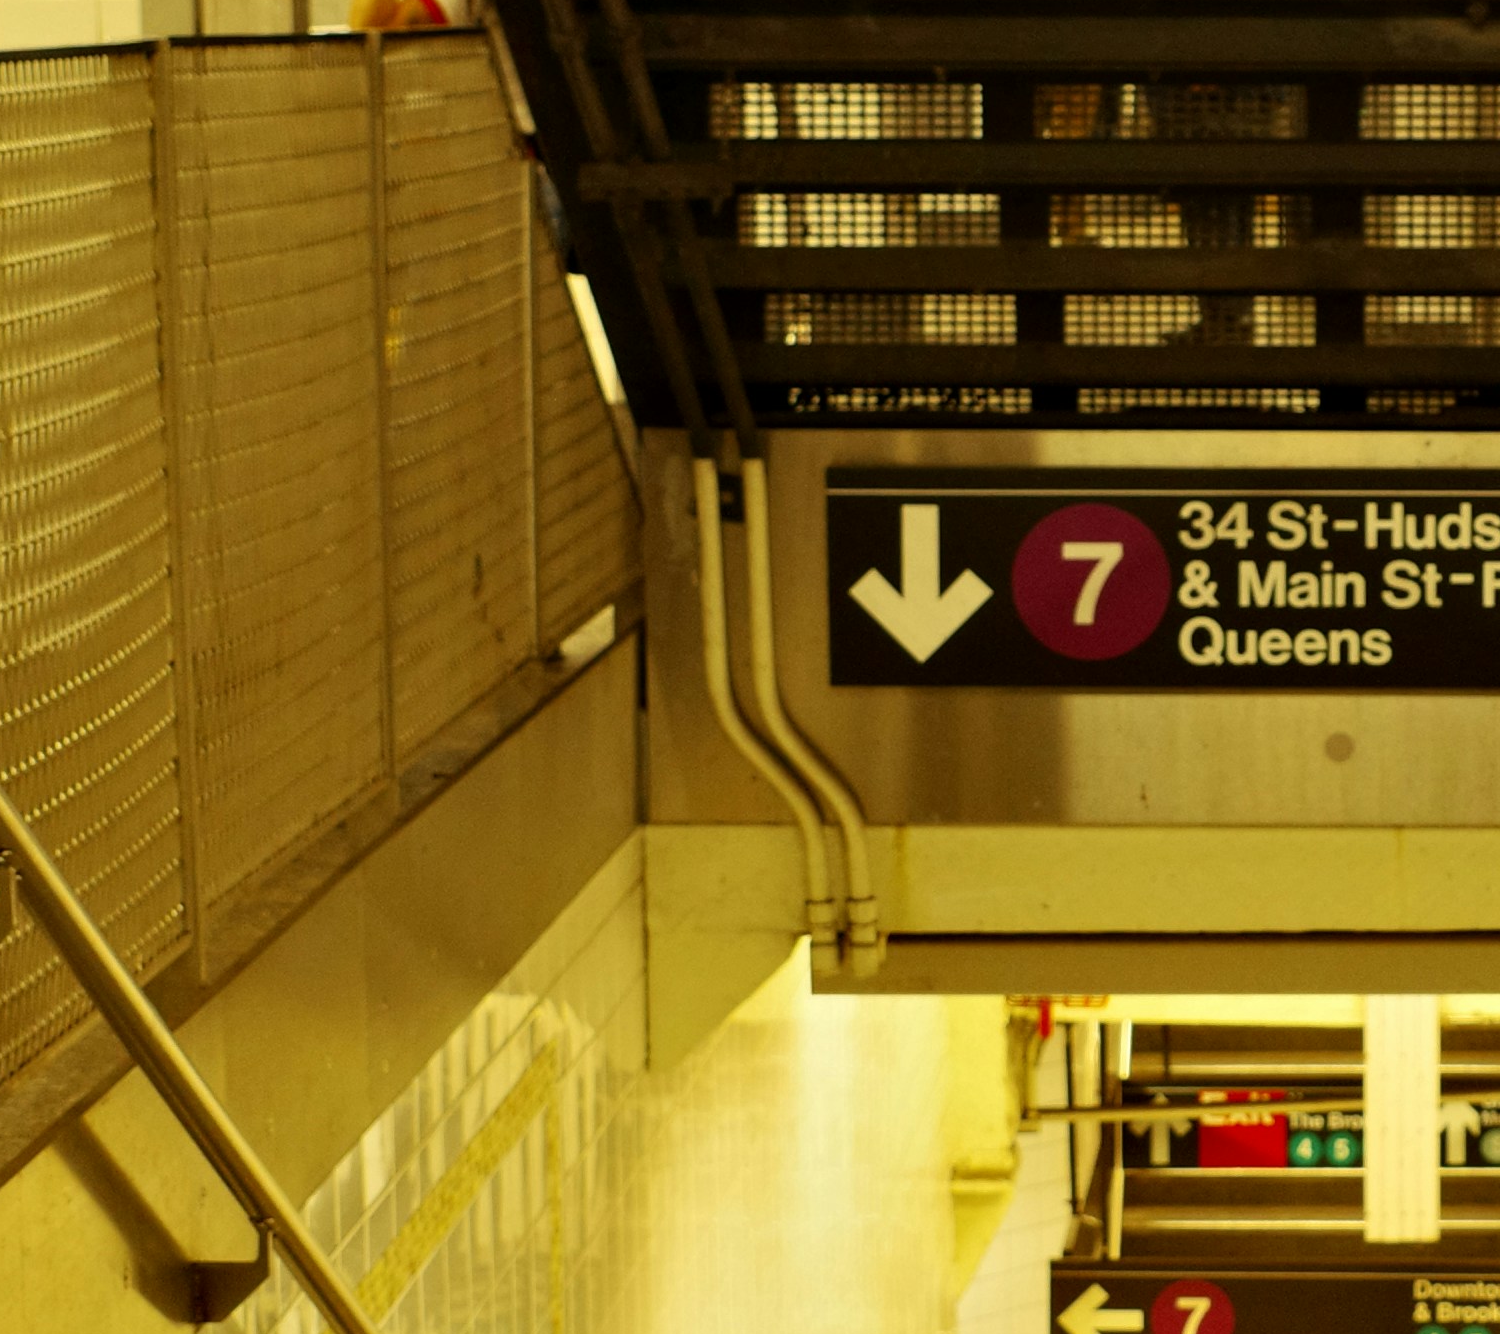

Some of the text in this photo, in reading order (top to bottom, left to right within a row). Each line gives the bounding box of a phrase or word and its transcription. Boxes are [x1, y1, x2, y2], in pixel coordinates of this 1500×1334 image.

[1177, 500, 1253, 551] 34
[1061, 540, 1125, 626] 7
[1178, 560, 1219, 609] &
[1238, 560, 1366, 609] Main
[1178, 617, 1393, 667] Queens
[1296, 1137, 1350, 1161] 4 5
[1413, 1303, 1431, 1323] &
